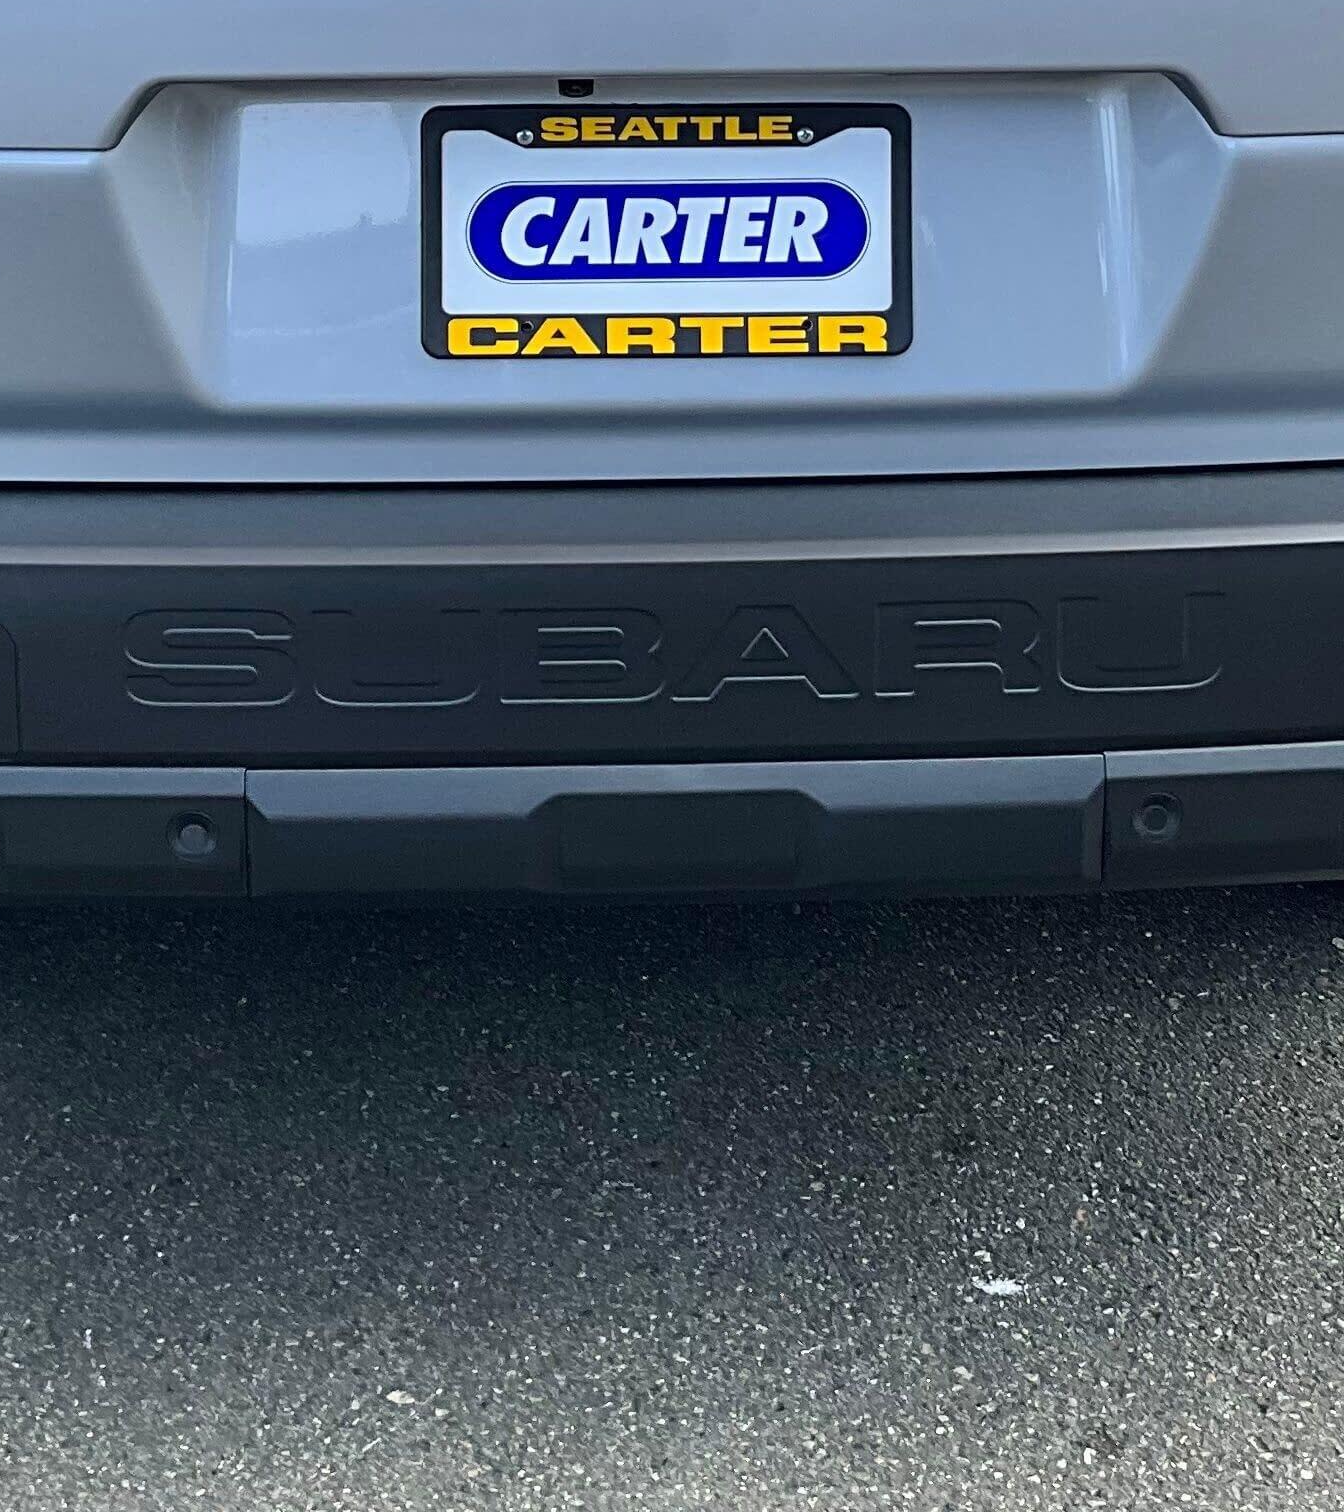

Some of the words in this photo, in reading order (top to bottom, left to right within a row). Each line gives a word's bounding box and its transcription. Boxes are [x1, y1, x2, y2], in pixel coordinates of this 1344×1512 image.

[540, 115, 794, 142] SEATTLE
[500, 195, 829, 267] CARTER
[447, 315, 888, 356] CARTER
[123, 592, 1227, 706] SUBARU
